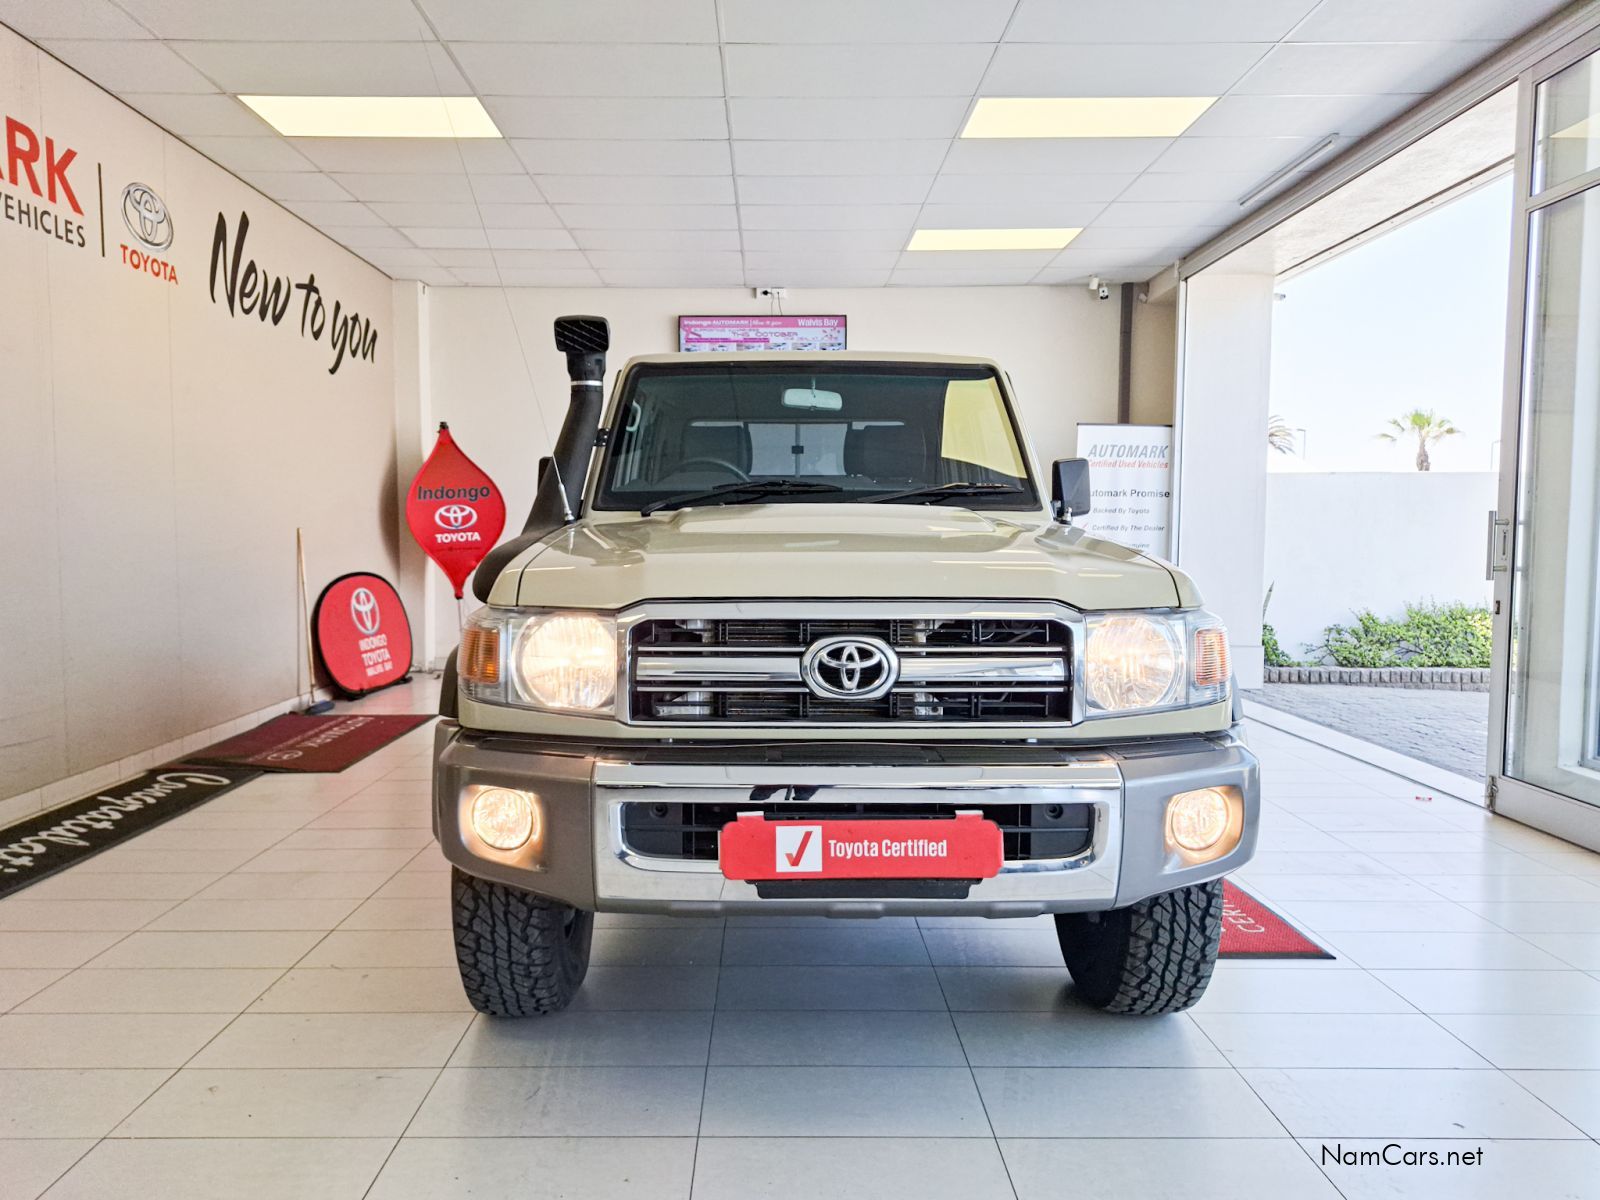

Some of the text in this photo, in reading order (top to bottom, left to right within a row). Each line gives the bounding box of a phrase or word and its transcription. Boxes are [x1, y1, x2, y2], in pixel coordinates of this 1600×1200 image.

[0, 115, 85, 217] RK
[0, 191, 86, 248] EHICLES
[120, 243, 179, 285] TOYOTA
[209, 211, 378, 375] New to you
[798, 318, 839, 328] Walvis Bay
[1088, 444, 1169, 459] AUTOMARK
[1118, 460, 1137, 469] Used
[1138, 460, 1169, 469] Vehicles
[417, 485, 491, 502] Indongo
[1090, 489, 1171, 498] utomark Promise
[1118, 507, 1126, 515] By
[1127, 507, 1150, 515] Toyota
[1092, 524, 1165, 532] Certified By The Dealer
[435, 531, 481, 544] TOYOTA
[358, 633, 388, 652] INDONGO
[361, 645, 392, 667] TOYOTA
[0, 771, 231, 873] Congratulat
[828, 838, 948, 858] Toyota Certified
